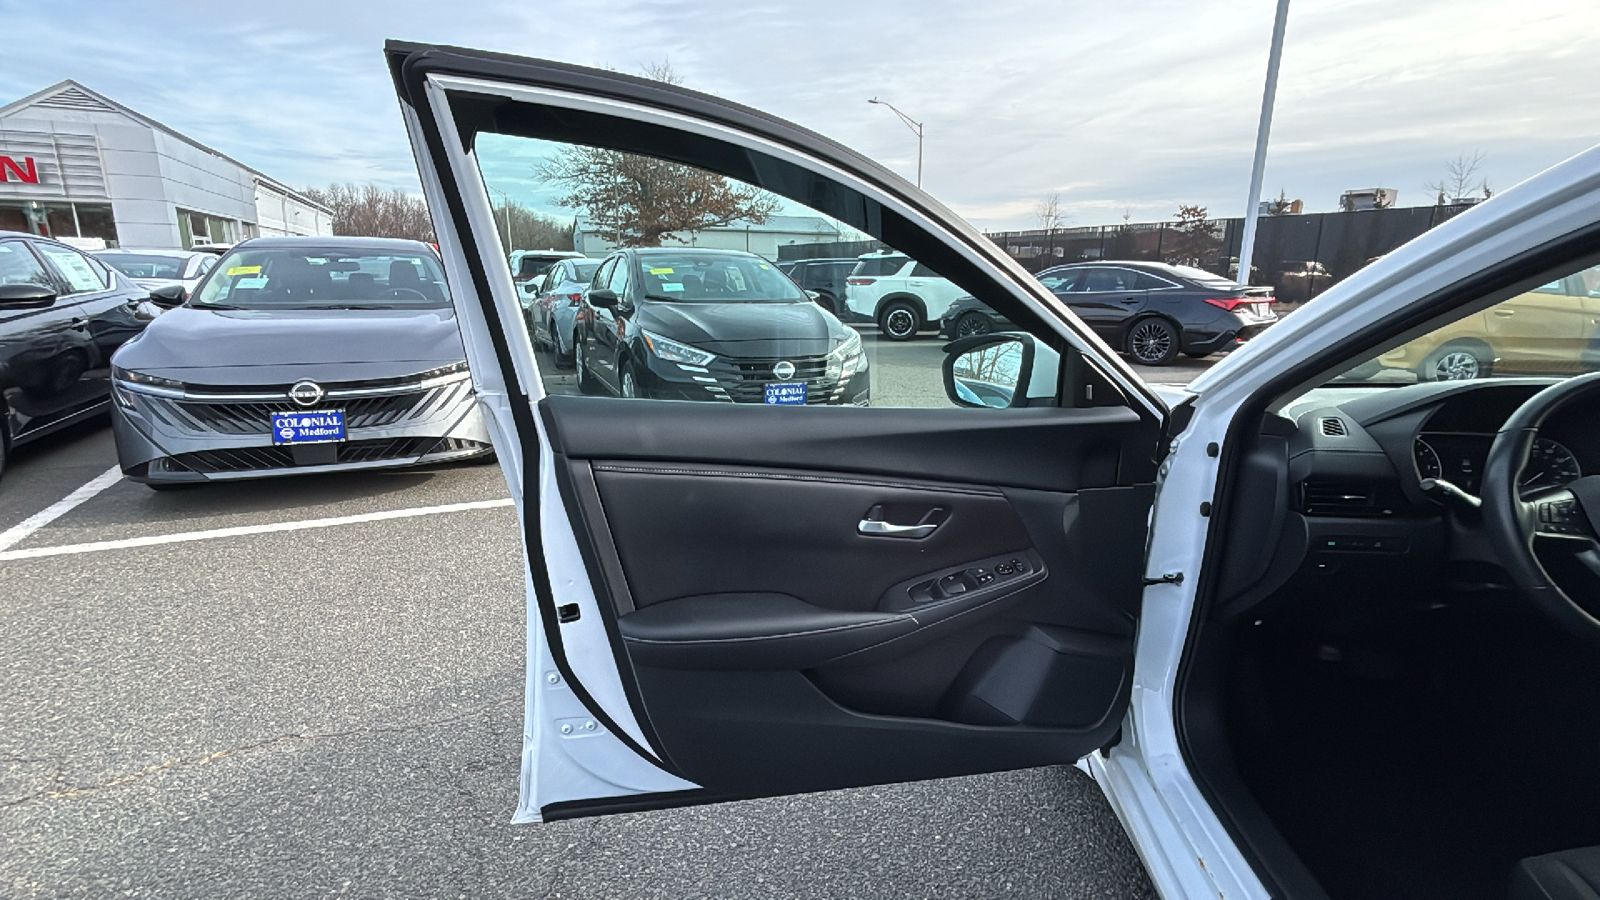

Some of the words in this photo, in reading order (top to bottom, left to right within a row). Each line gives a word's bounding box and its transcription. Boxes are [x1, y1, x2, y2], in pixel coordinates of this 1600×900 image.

[0, 155, 40, 183] N
[766, 387, 805, 396] COLONIAL
[275, 416, 341, 428] COLONIAL
[299, 427, 339, 437] Medford
